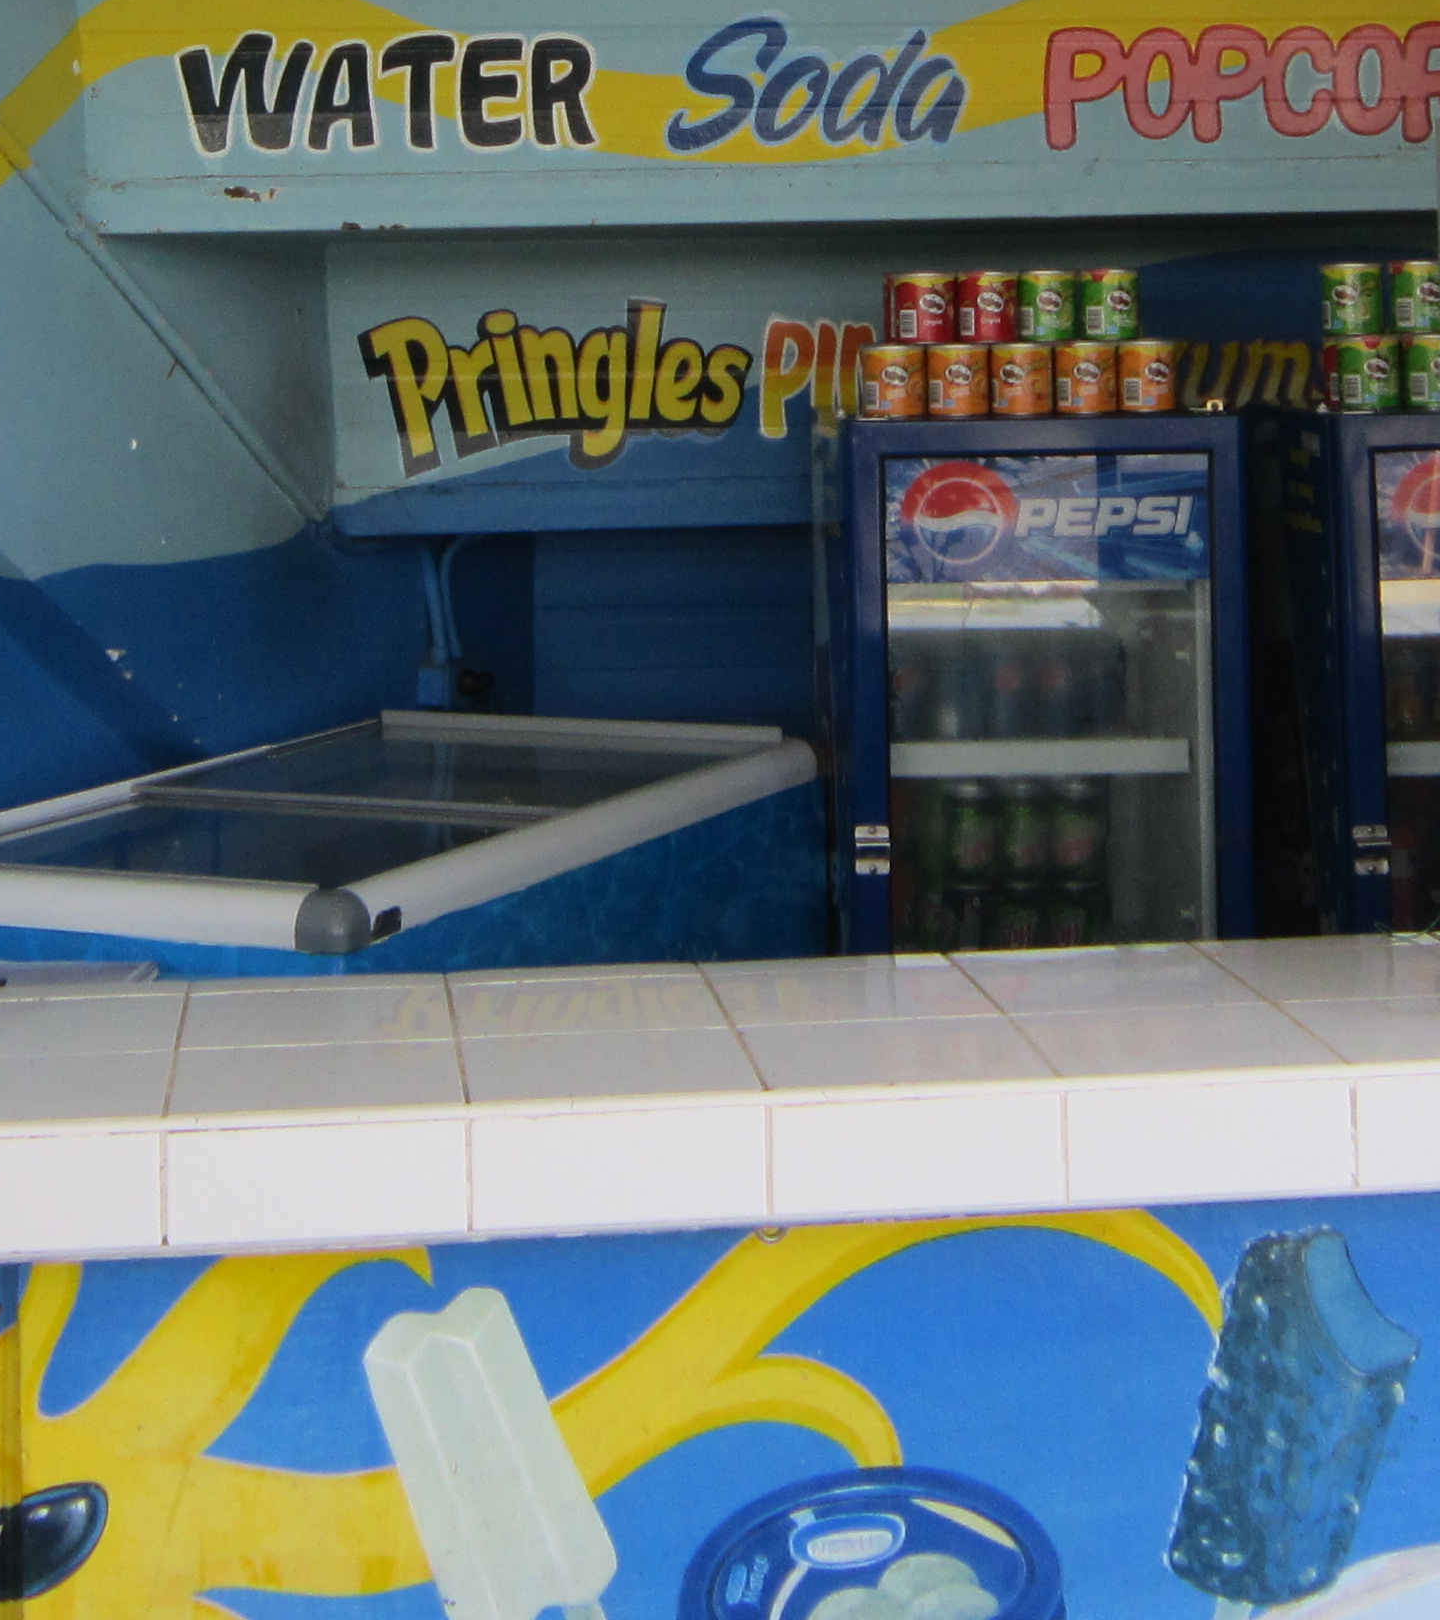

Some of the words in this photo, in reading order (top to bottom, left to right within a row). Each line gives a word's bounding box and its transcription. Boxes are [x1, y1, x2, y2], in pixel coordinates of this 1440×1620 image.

[183, 30, 600, 155] WATER
[666, 15, 968, 155] Soda
[361, 297, 753, 479] Pringles
[1013, 495, 1193, 539] PEPSI
